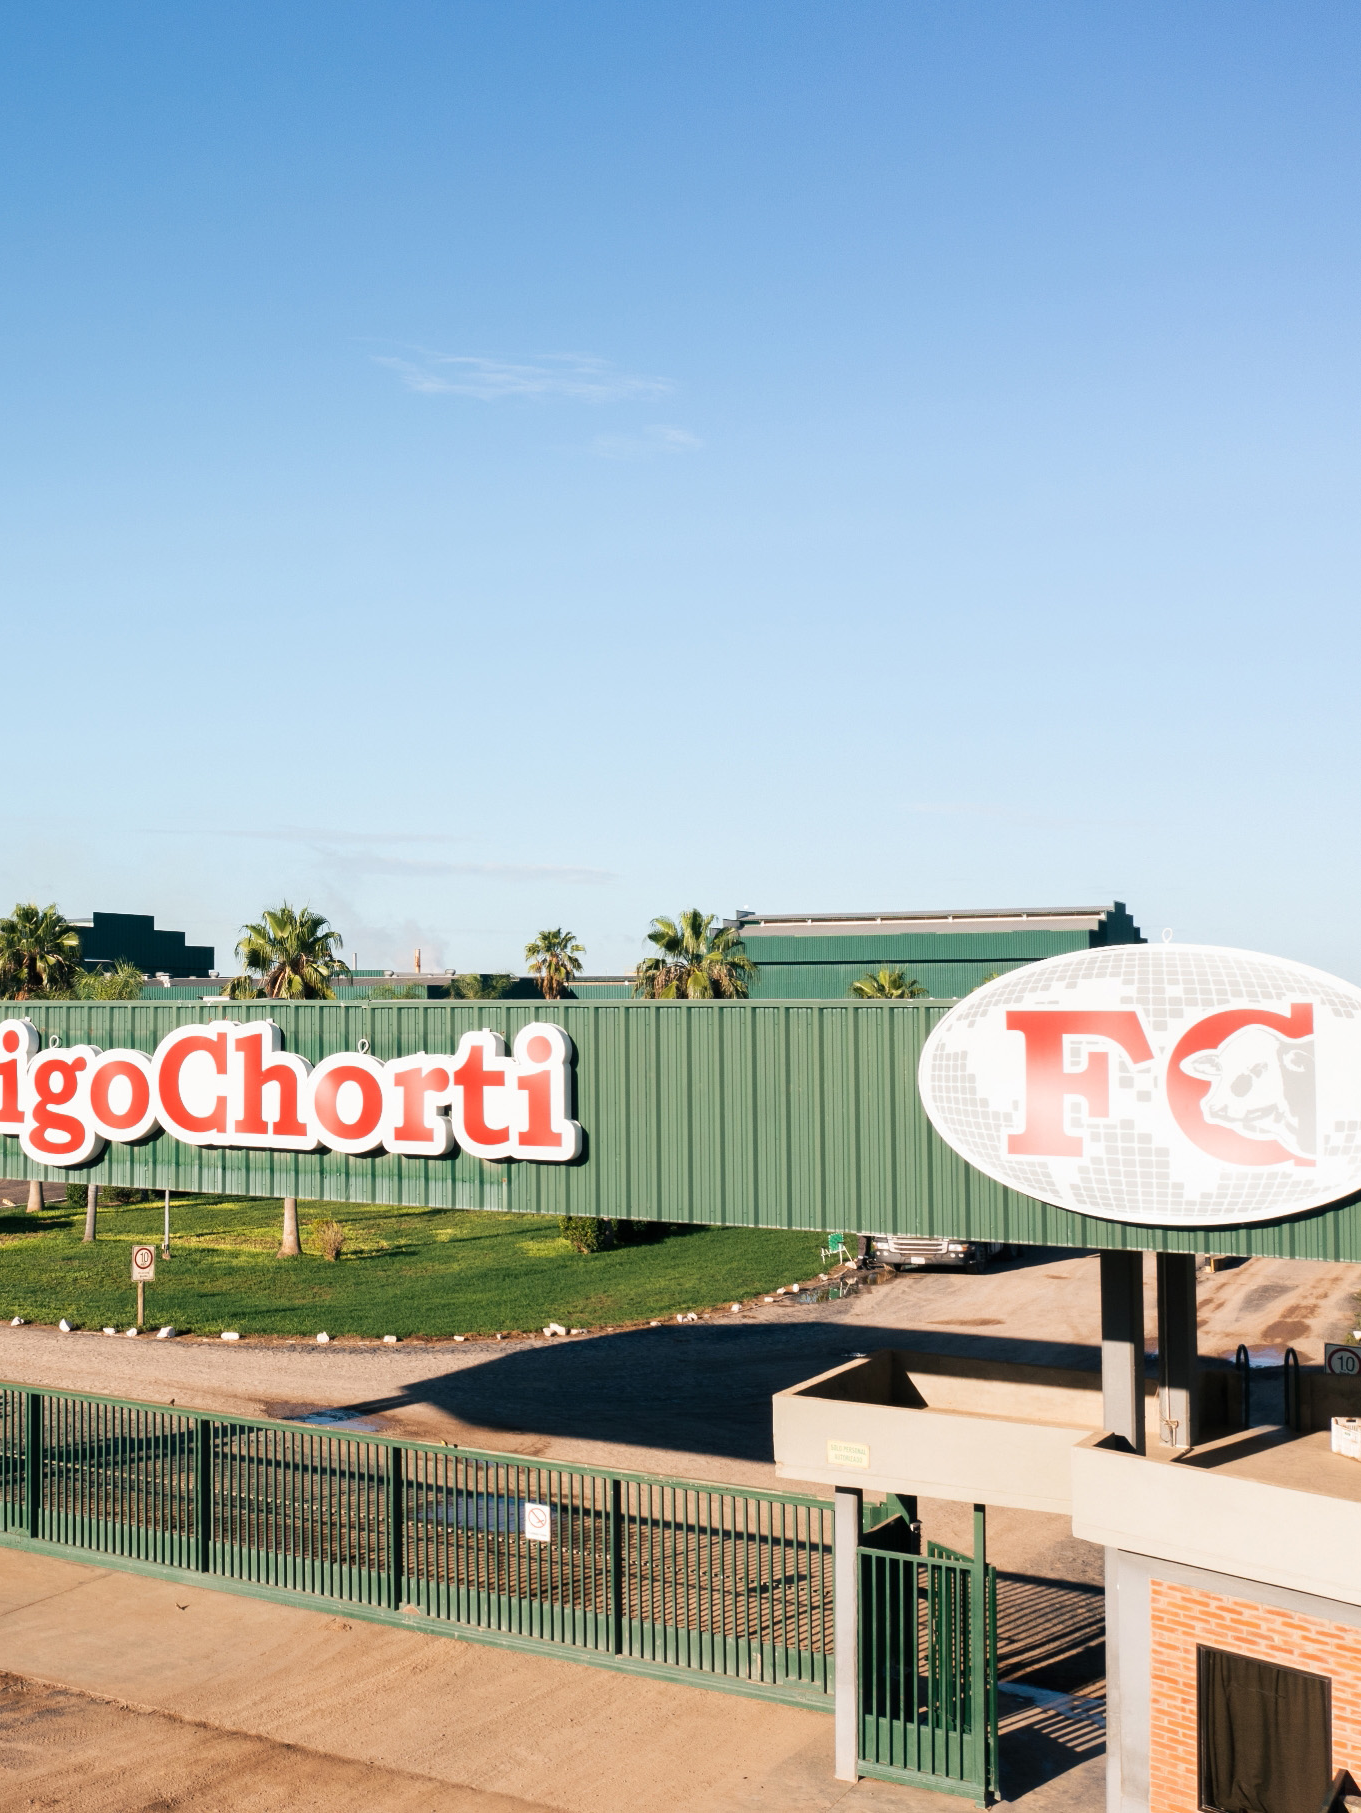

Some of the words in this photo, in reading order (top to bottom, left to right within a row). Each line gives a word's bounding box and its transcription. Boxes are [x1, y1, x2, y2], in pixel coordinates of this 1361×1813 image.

[1006, 1003, 1317, 1167] FC
[140, 1251, 149, 1263] 10
[1337, 1355, 1355, 1372] 10
